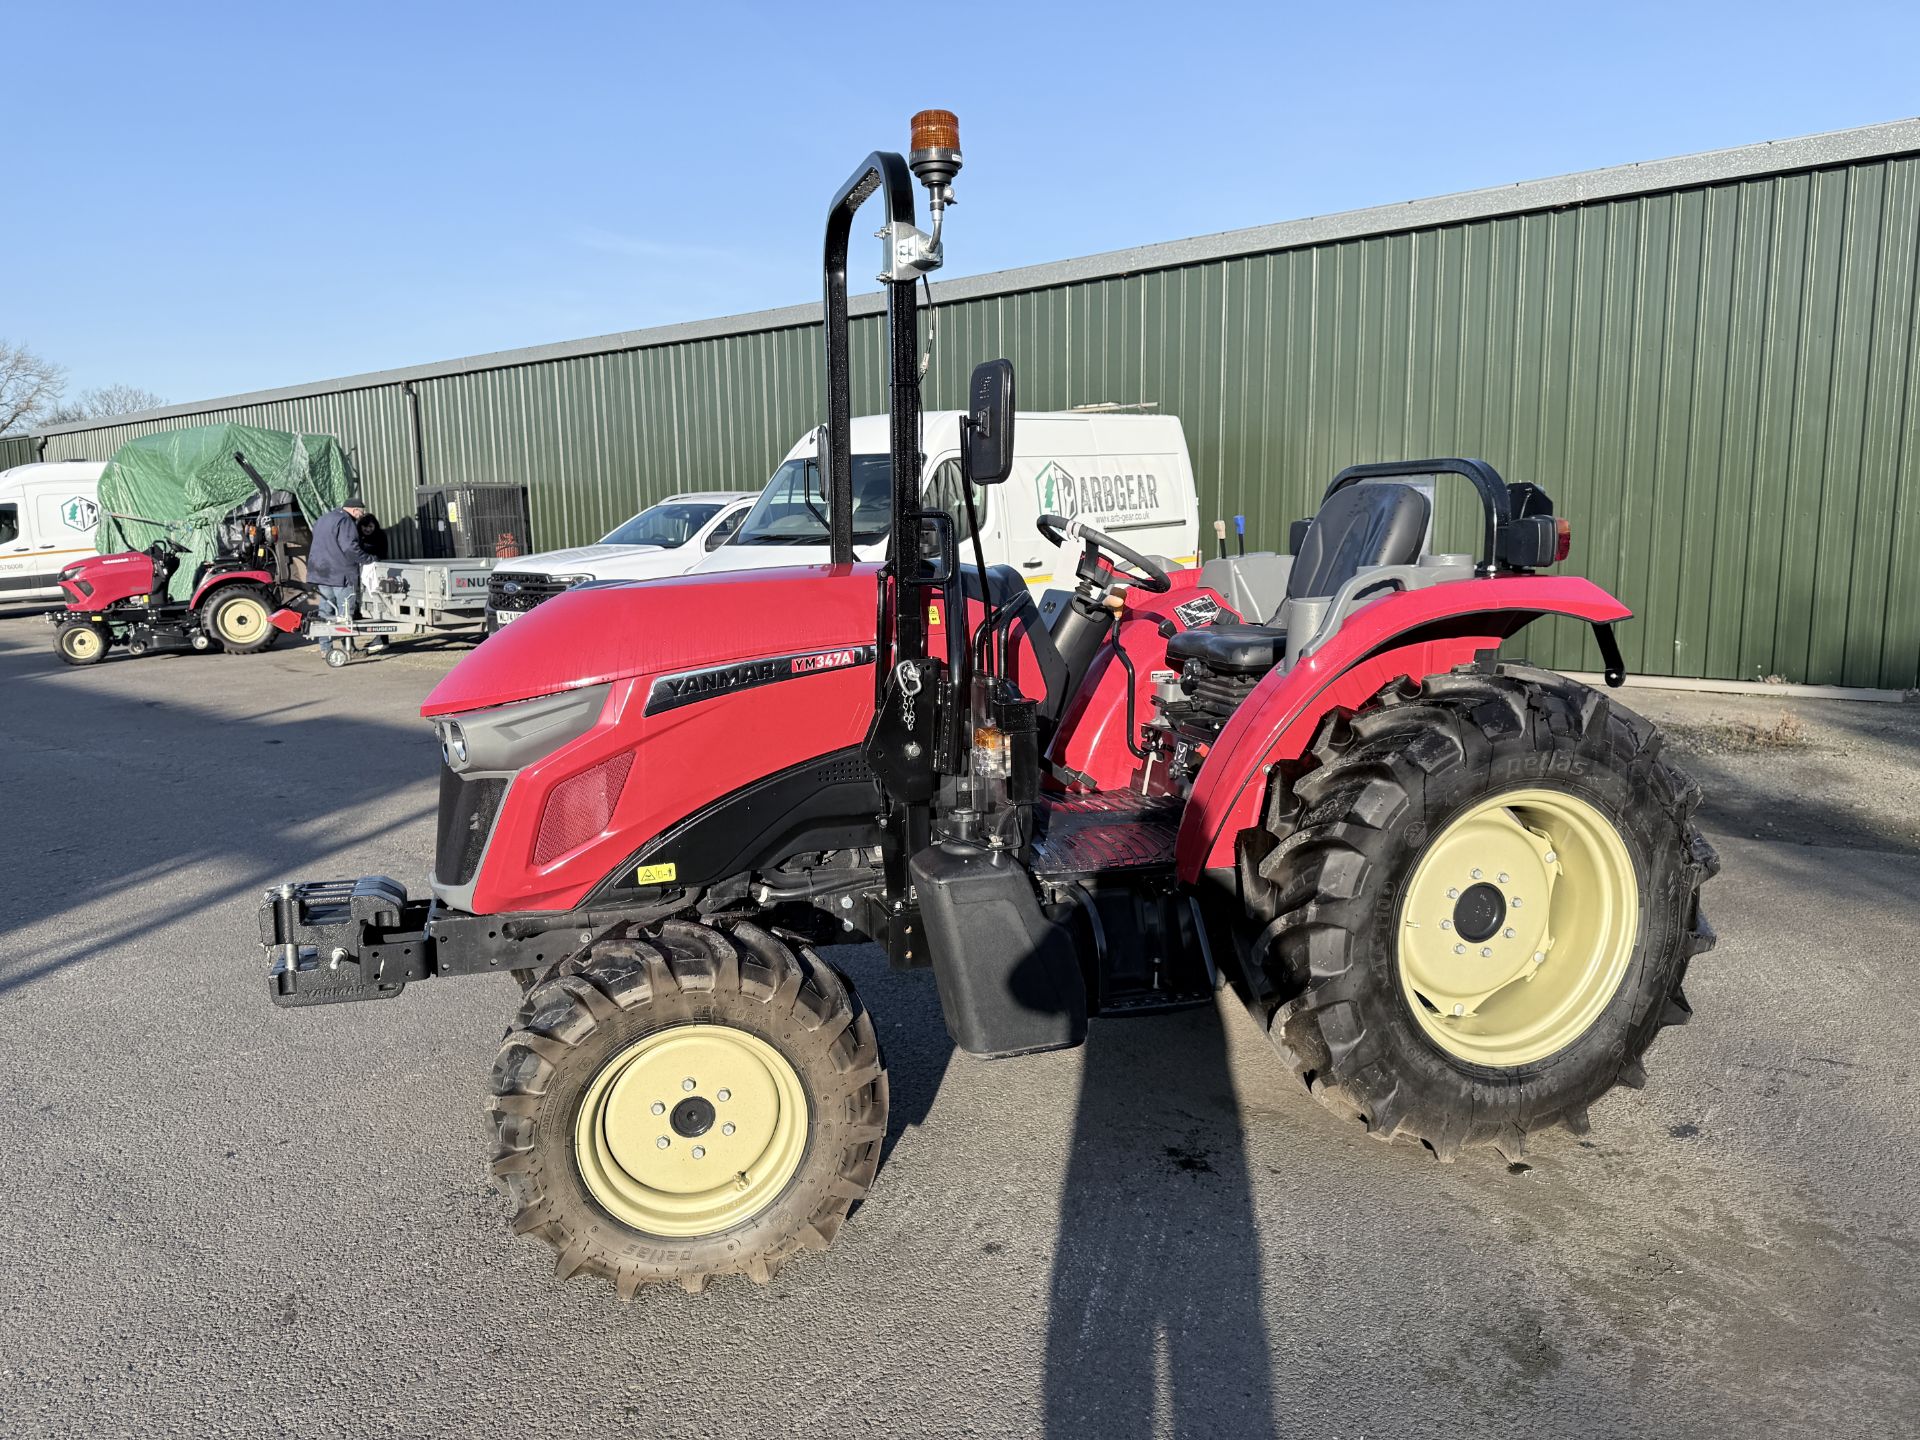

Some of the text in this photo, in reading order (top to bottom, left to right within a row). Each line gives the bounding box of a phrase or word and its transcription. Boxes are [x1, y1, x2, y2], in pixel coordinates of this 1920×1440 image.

[1080, 474, 1160, 513] ARBGEAR
[1095, 511, 1151, 525] www.arb-gear.co.uk
[796, 651, 851, 670] YM347A
[667, 663, 776, 697] YANMAR
[1506, 749, 1588, 779] petlas
[622, 1243, 696, 1263] petlas
